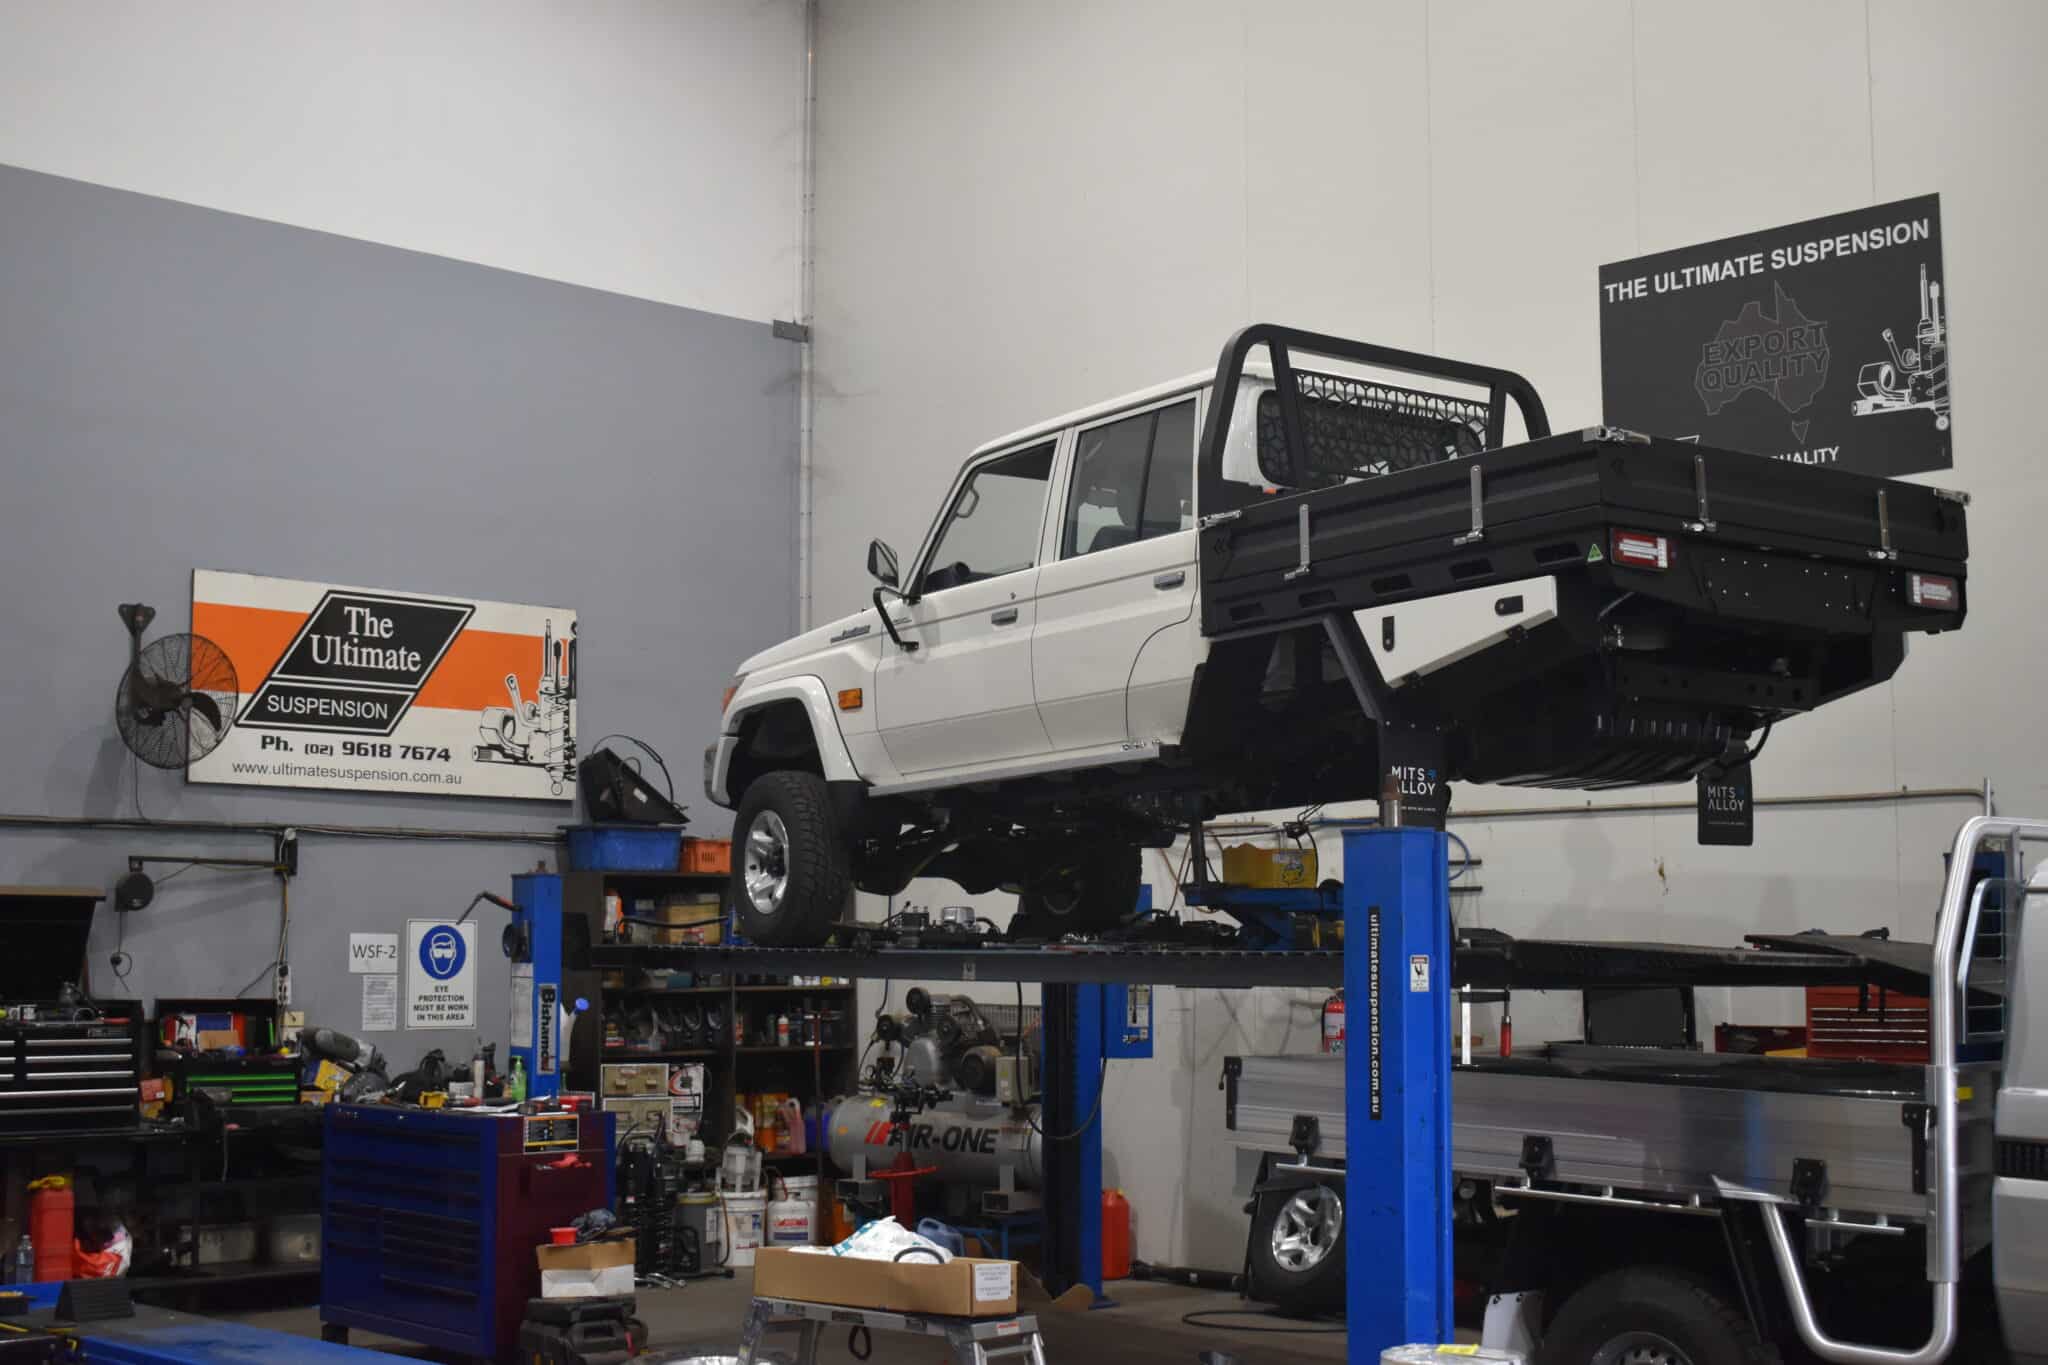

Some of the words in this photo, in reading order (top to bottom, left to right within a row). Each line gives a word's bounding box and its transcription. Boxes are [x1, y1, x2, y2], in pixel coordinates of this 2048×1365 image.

[1604, 276, 1648, 303] THE
[1654, 252, 1764, 293] ULTIMATE
[1771, 218, 1929, 269] SUSPENSION
[1702, 320, 1827, 367] EXPORT
[1701, 350, 1829, 392] QUALITY
[1769, 446, 1839, 464] ALITY
[344, 606, 394, 638] The
[310, 634, 422, 672] Ultimate
[267, 695, 388, 720] SUSPENSION
[261, 735, 293, 752] Ph.
[304, 743, 334, 756] (02)
[342, 741, 392, 758] 9618
[399, 745, 451, 762] 7674
[232, 761, 462, 784] www.ultimatesuspension.com.au
[1391, 765, 1425, 781] MITS
[1707, 785, 1736, 799] MITS
[1708, 799, 1745, 811] ALLOY
[352, 943, 396, 959] WSF-2
[418, 994, 465, 1002] PROTECTION
[434, 985, 449, 993] EYE
[427, 1013, 444, 1021] THIS
[446, 1013, 465, 1021] AREA
[1370, 914, 1380, 1113] ultimatesuspension.com.au
[888, 1124, 998, 1153] AIR-ONE
